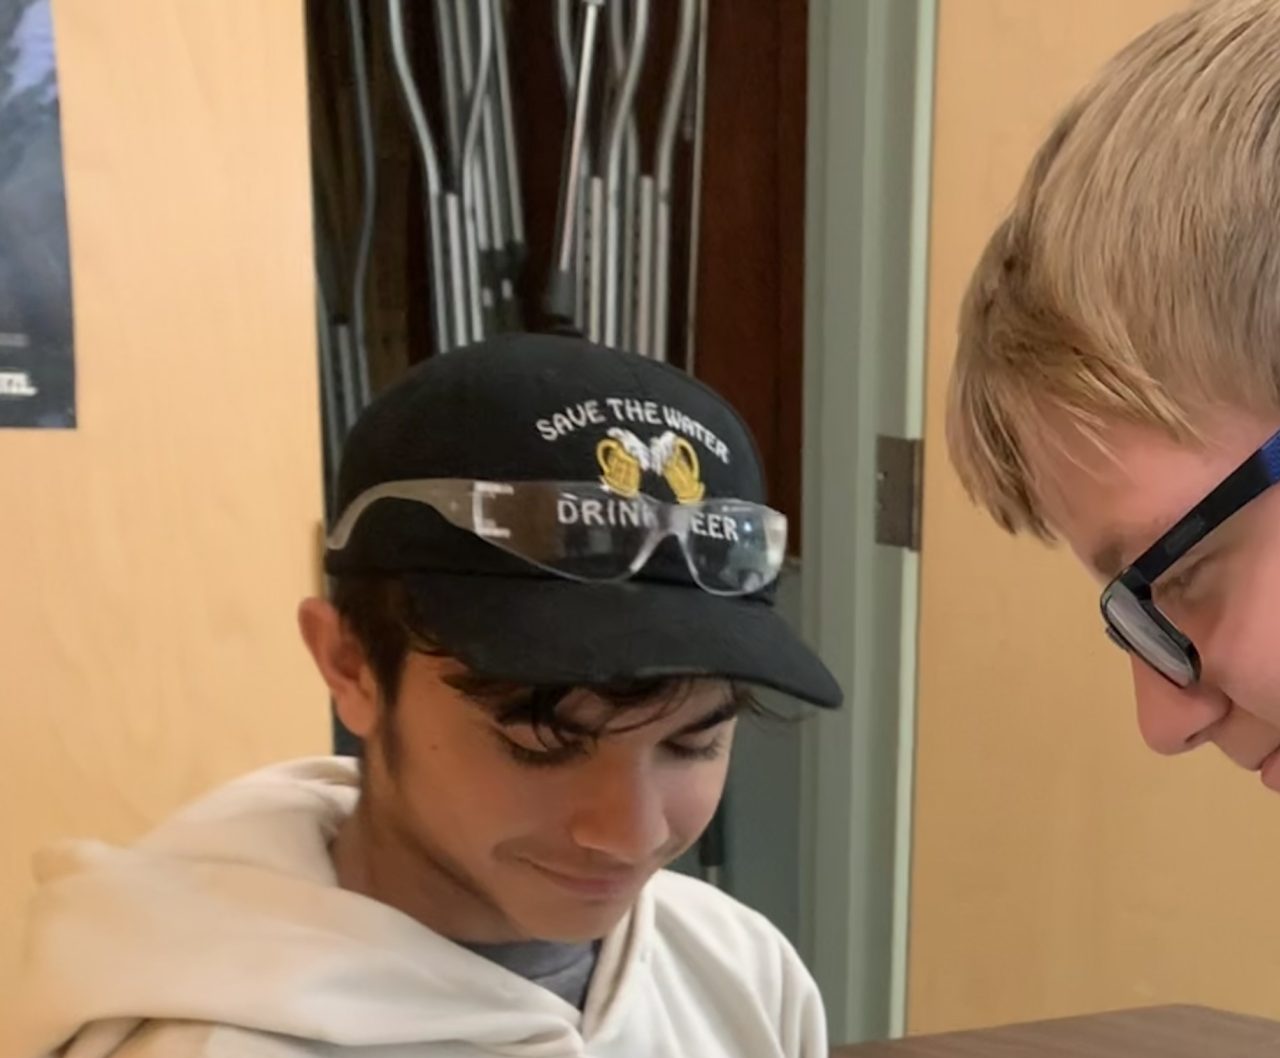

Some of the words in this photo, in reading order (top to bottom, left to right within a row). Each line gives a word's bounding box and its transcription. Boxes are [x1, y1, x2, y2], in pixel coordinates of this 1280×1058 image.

[536, 400, 605, 441] SAVE
[605, 397, 663, 425] THE
[662, 405, 729, 464] WATER
[688, 510, 739, 541] EER
